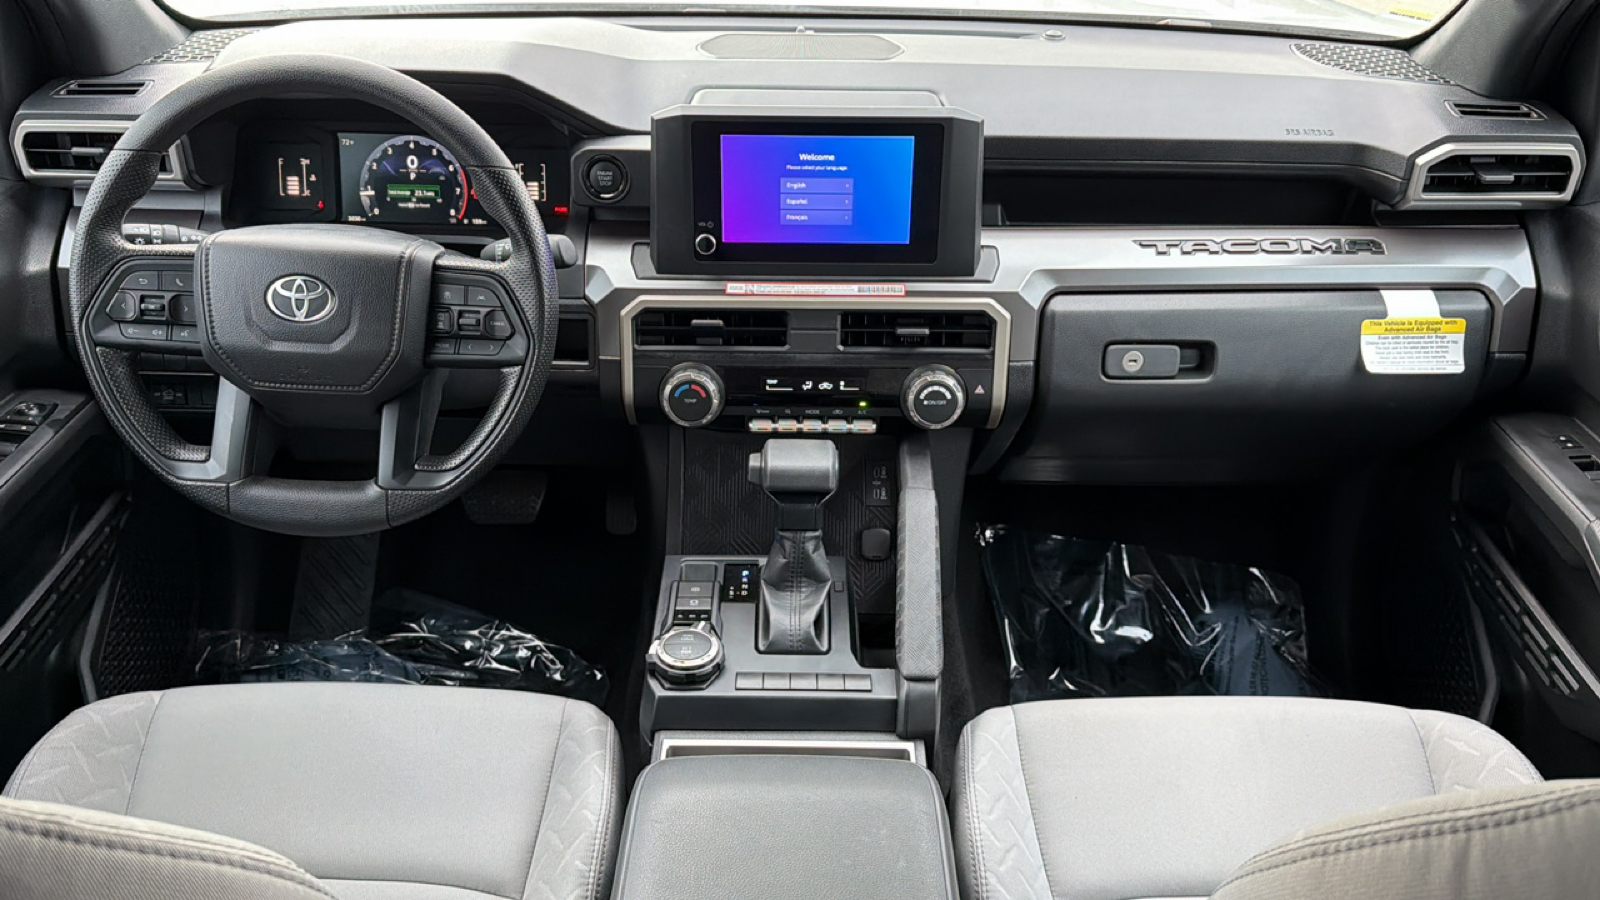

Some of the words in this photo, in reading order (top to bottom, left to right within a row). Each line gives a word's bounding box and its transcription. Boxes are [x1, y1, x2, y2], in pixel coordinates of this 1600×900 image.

[799, 153, 835, 161] Welcome
[406, 155, 418, 169] 0
[410, 172, 416, 180] P
[1132, 239, 1387, 256] TACOMA
[1414, 320, 1443, 328] Equipped
